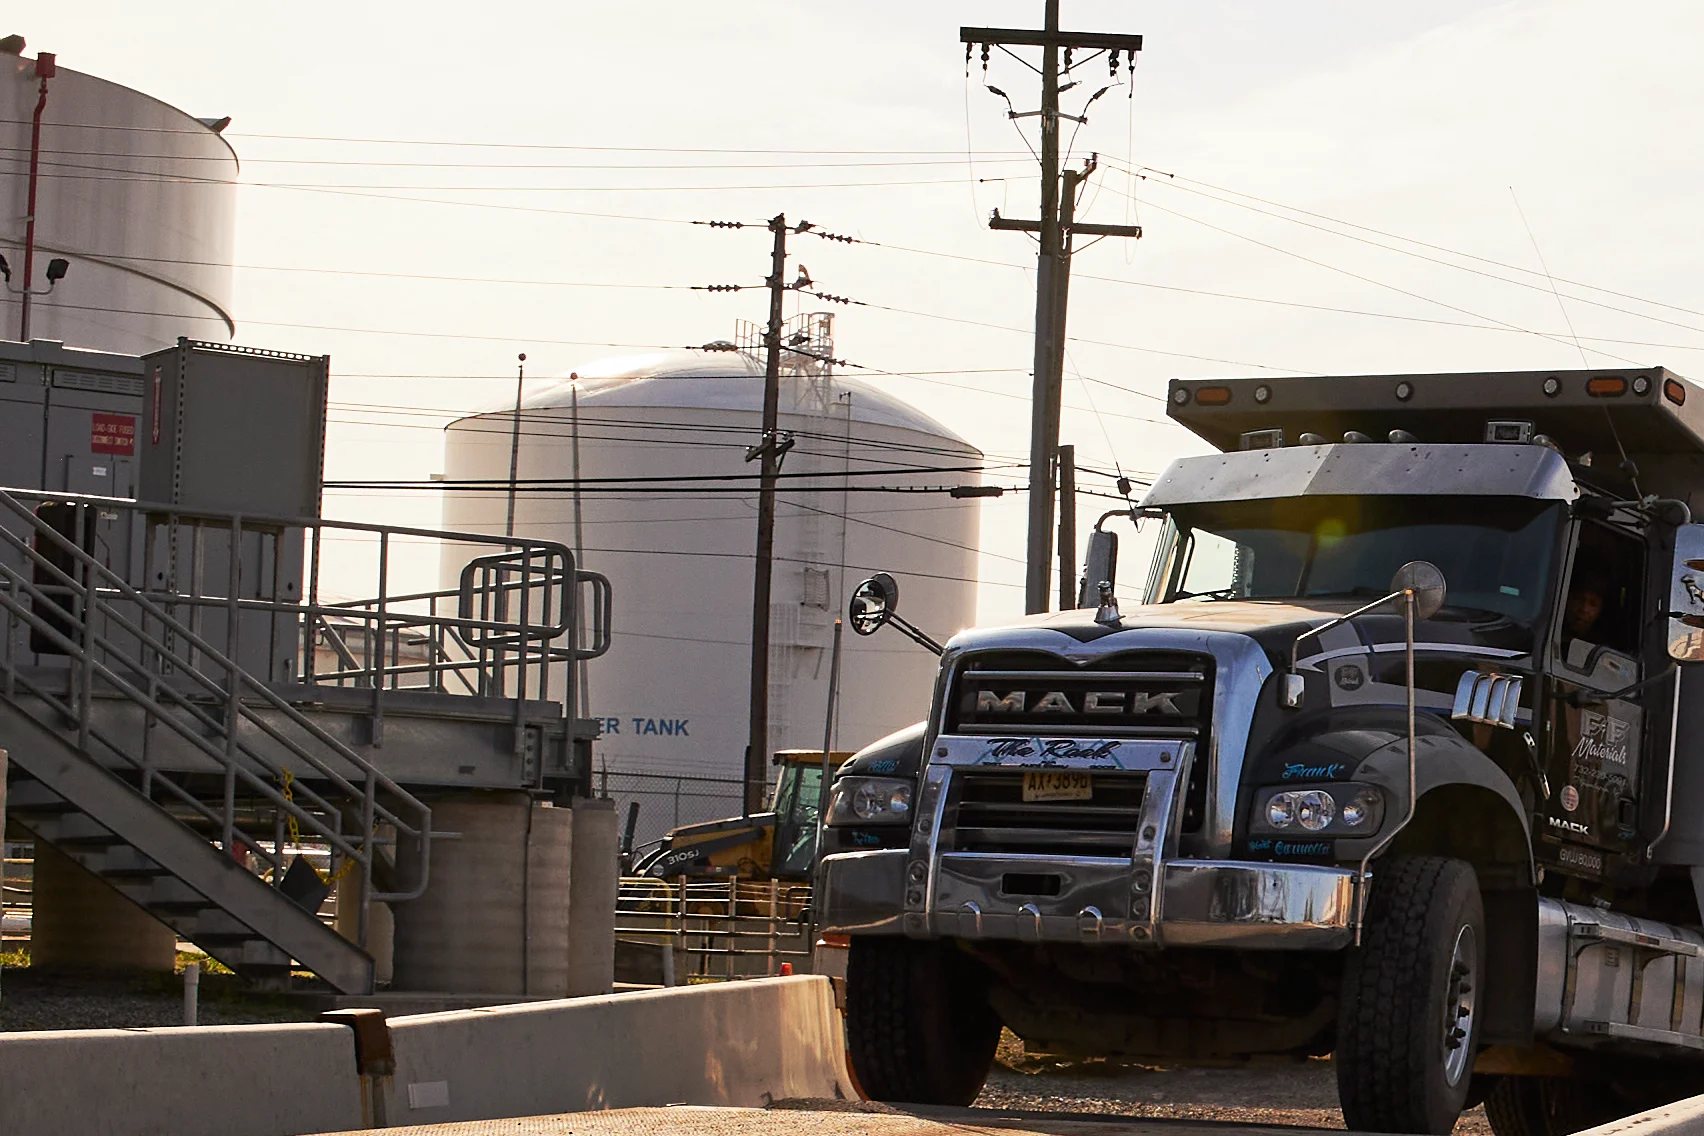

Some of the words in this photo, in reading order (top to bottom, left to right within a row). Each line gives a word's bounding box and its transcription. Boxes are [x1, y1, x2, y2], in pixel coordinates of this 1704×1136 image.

[976, 690, 1184, 715] MACK
[632, 718, 689, 736] TANK
[986, 738, 1036, 758] The
[1571, 735, 1627, 765] Materials
[1549, 816, 1589, 835] MACK
[1559, 848, 1579, 864] GVW
